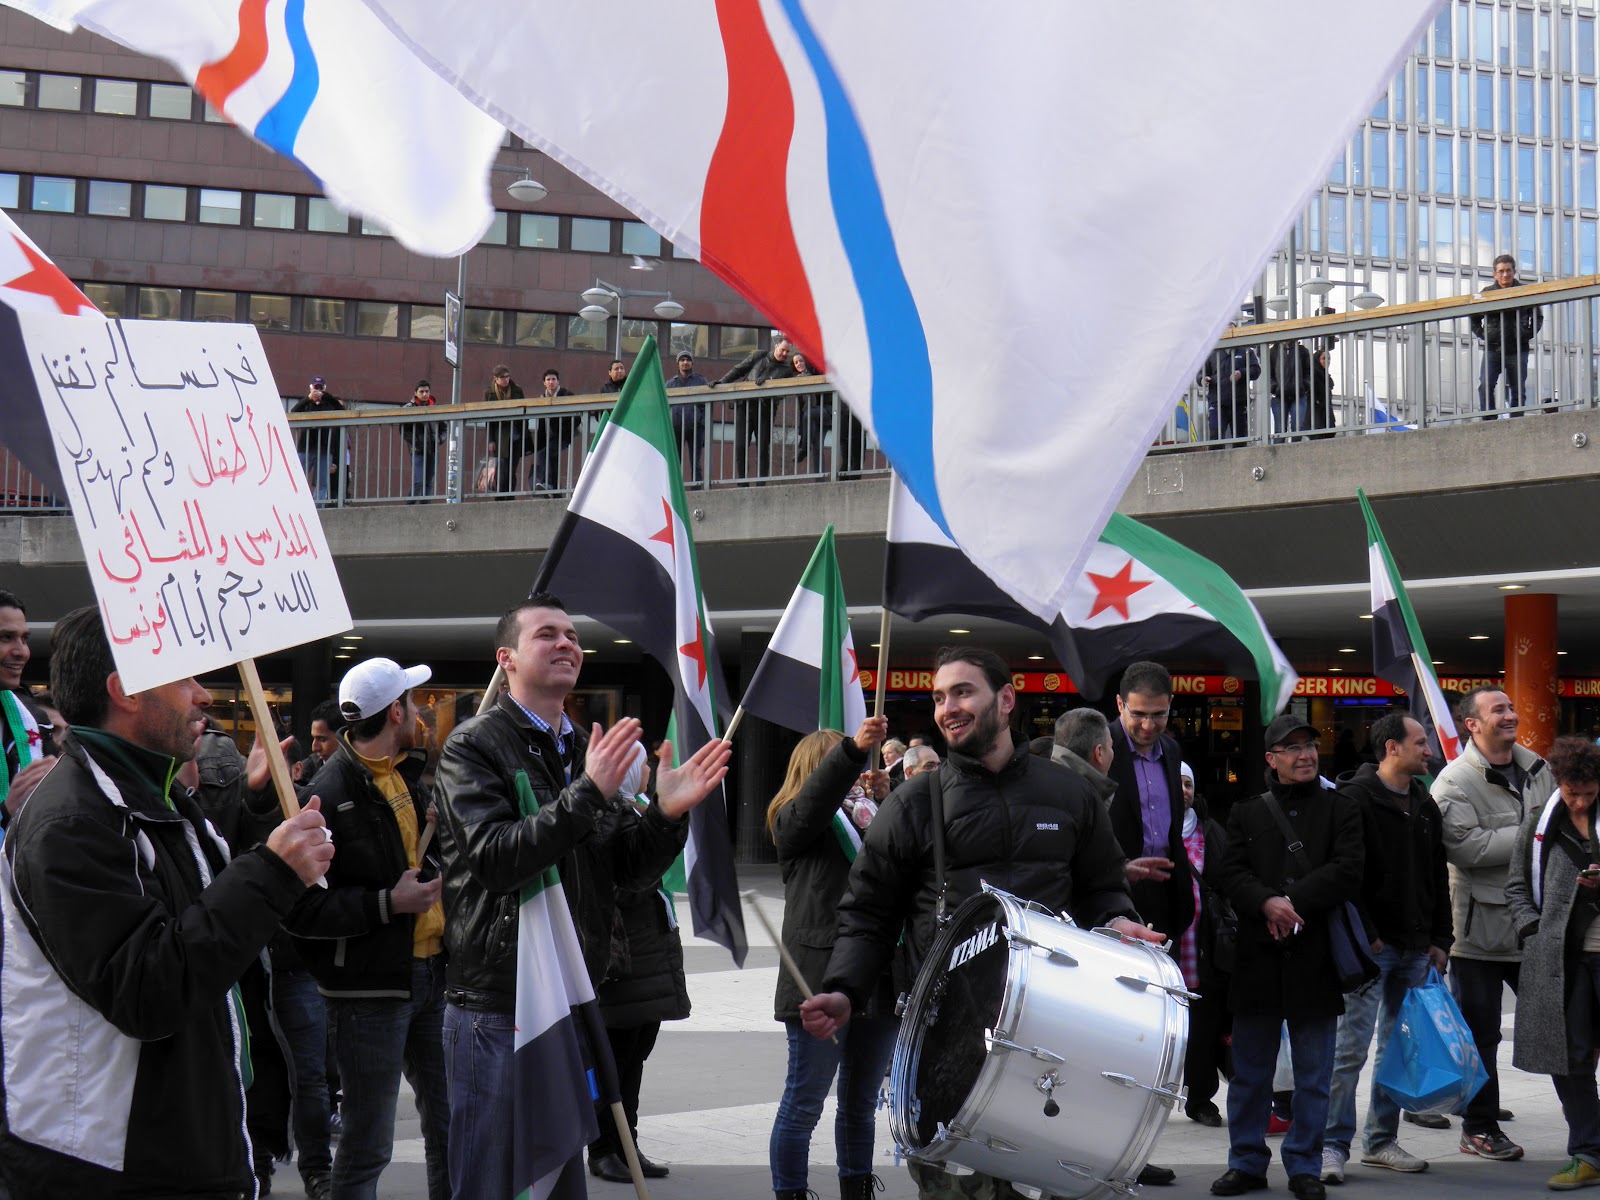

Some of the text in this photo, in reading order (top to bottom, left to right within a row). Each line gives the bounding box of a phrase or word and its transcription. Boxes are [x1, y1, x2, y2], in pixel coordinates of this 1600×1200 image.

[41, 319, 258, 459] فرنسا لم تقتل
[274, 570, 319, 613] الله
[891, 671, 934, 688] BUR
[1172, 677, 1206, 692] ING
[1293, 678, 1328, 694] GER
[1332, 679, 1377, 695] KING
[1574, 680, 1600, 695] BUR
[951, 922, 998, 969] TAMA
